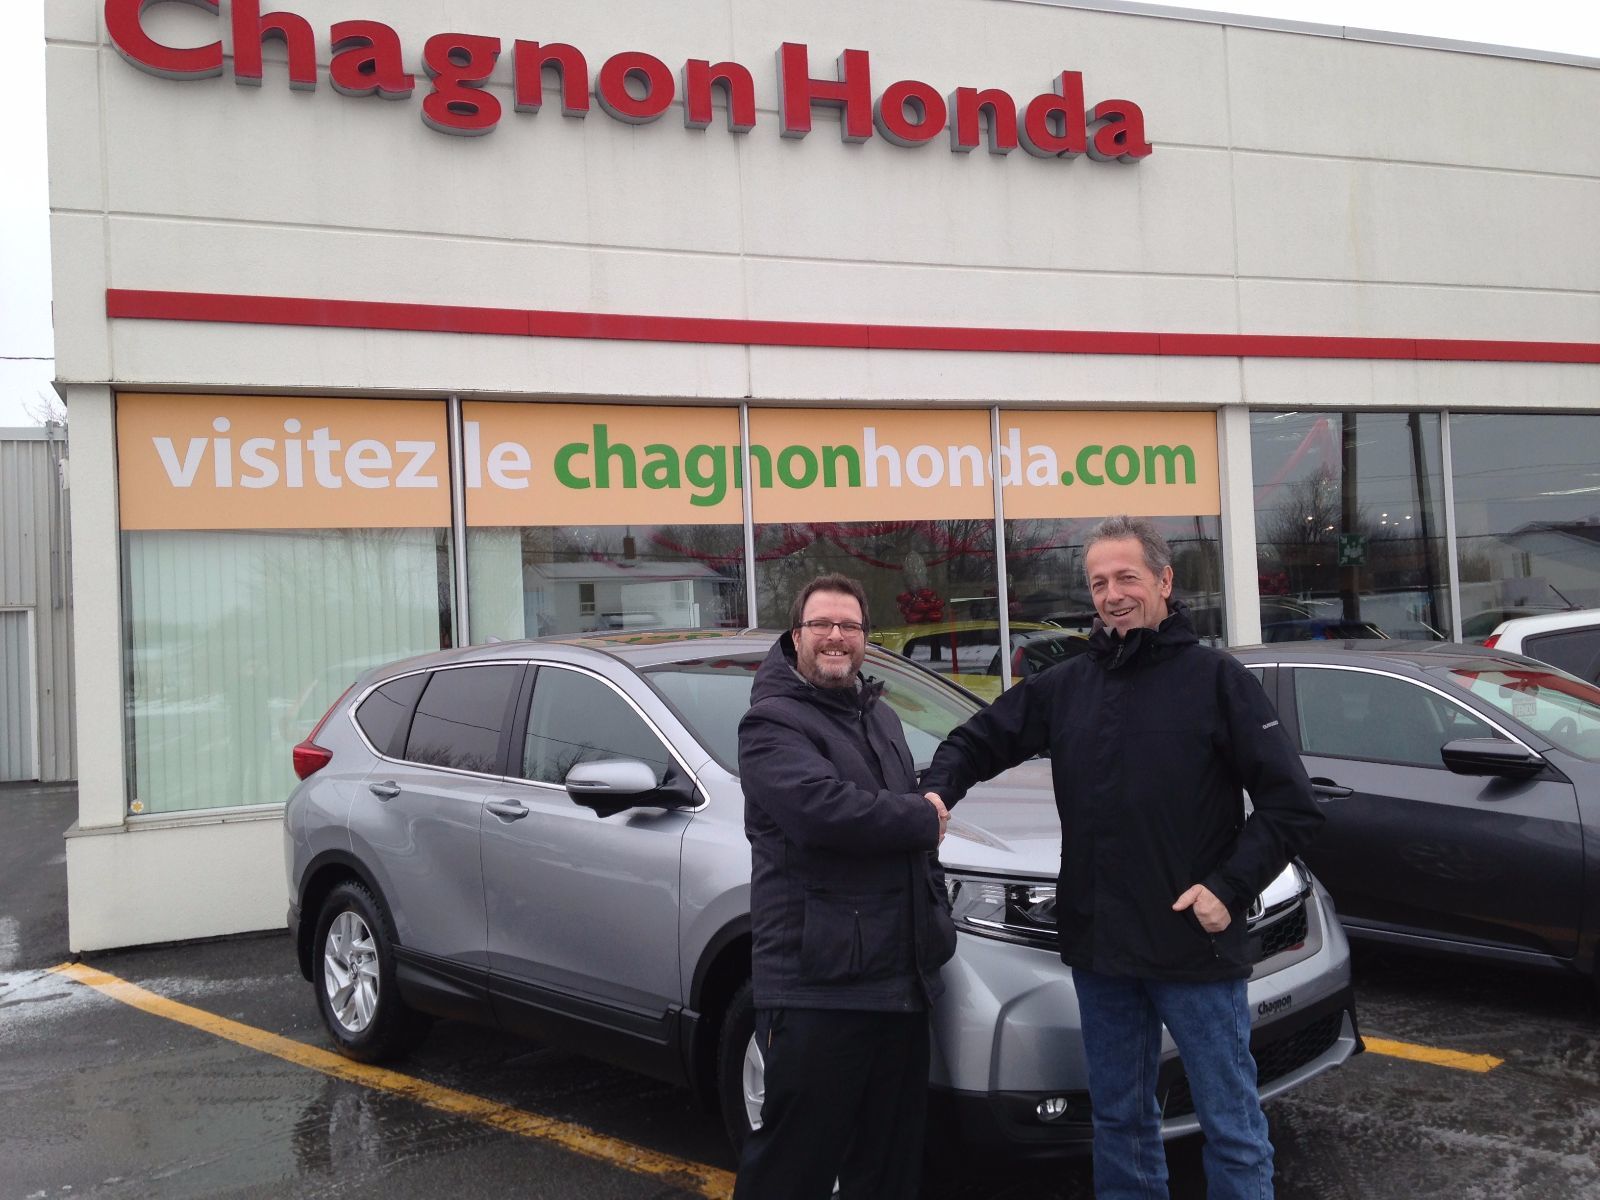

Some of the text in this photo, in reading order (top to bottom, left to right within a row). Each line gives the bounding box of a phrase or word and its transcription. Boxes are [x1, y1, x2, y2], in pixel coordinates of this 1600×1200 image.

[104, 0, 1153, 163] Chagnon Honda
[153, 417, 1196, 506] visitez le chagnonhonda.com
[1257, 994, 1292, 1015] Chagnon
